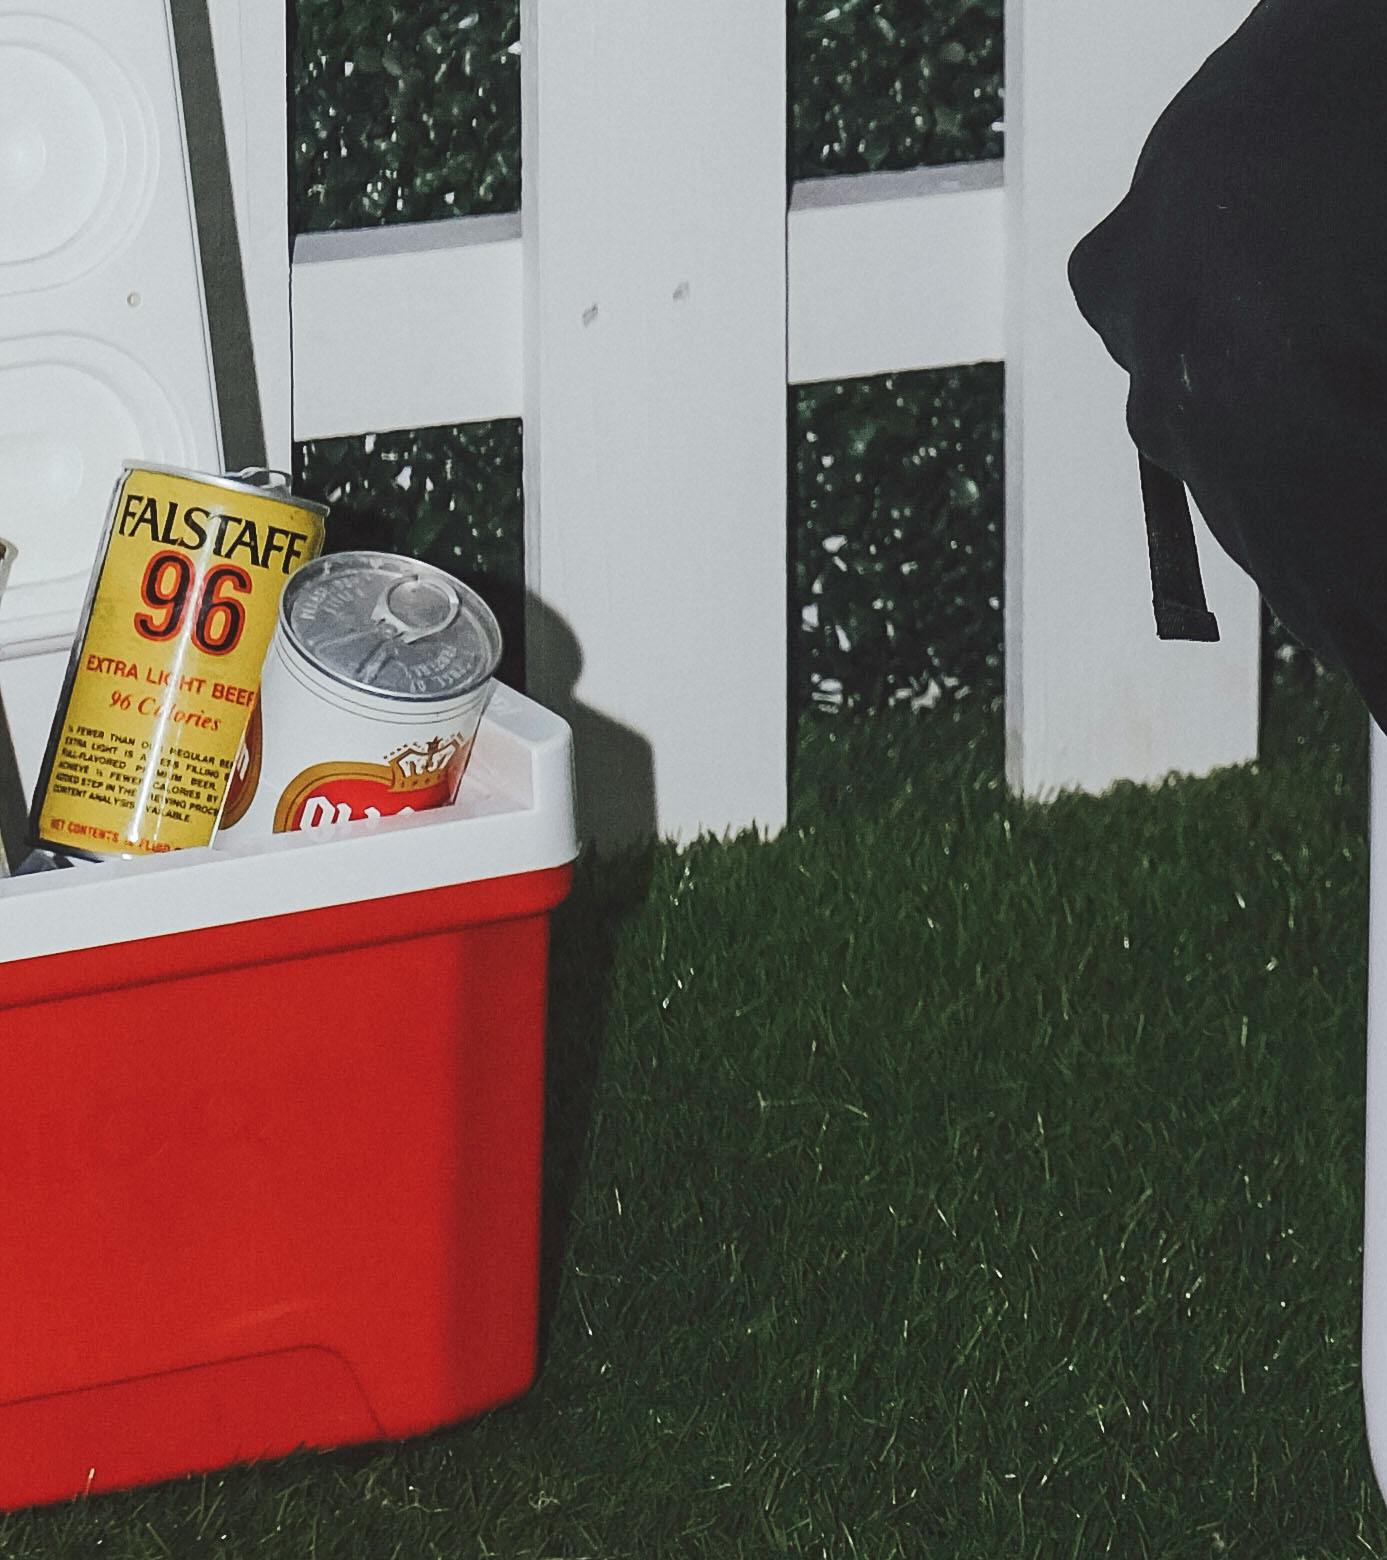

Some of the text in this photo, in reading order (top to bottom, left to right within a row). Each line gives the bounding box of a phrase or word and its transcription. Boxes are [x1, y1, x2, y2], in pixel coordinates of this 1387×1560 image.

[118, 494, 308, 575] FALSTAFF
[134, 549, 253, 657] 96
[86, 654, 138, 680] EXTRA
[110, 690, 132, 710] 96
[76, 726, 104, 739] FEWER
[110, 733, 135, 746] THAN
[92, 743, 118, 755] LIGHT
[124, 750, 134, 758] IS
[186, 763, 219, 778] FILLING
[207, 793, 218, 803] BY
